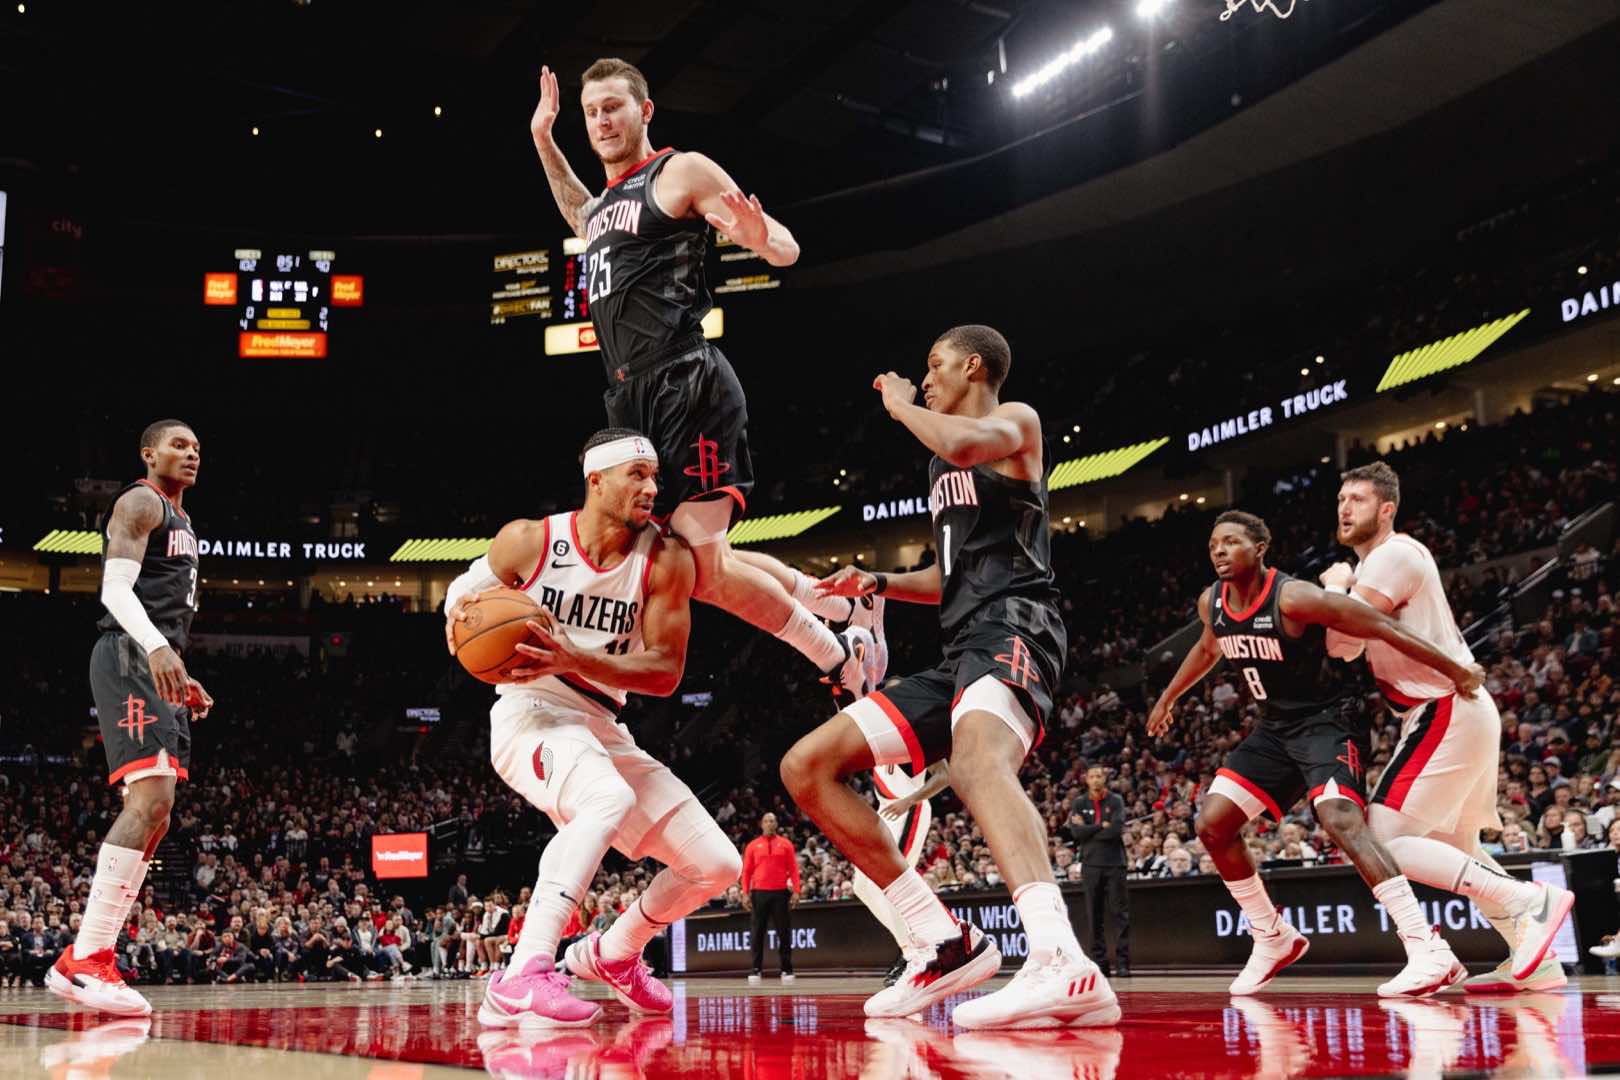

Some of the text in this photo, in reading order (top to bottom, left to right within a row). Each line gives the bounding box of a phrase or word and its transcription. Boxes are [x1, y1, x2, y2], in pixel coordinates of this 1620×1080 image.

[586, 199, 643, 248] OUSTON
[589, 246, 613, 304] 25
[1188, 379, 1348, 452] DAIMLER TRUCK
[863, 497, 933, 522] DAIML
[198, 540, 366, 559] DAIMLER TRUCK
[555, 541, 567, 556] 6
[943, 524, 952, 576] 1
[541, 585, 639, 635] BLAZERS
[1243, 667, 1268, 700] 8
[979, 904, 1020, 929] WHO
[1215, 900, 1492, 936] DALER TUCK
[697, 928, 817, 952] DAIMLE TUCK
[1001, 933, 1030, 957] MO
